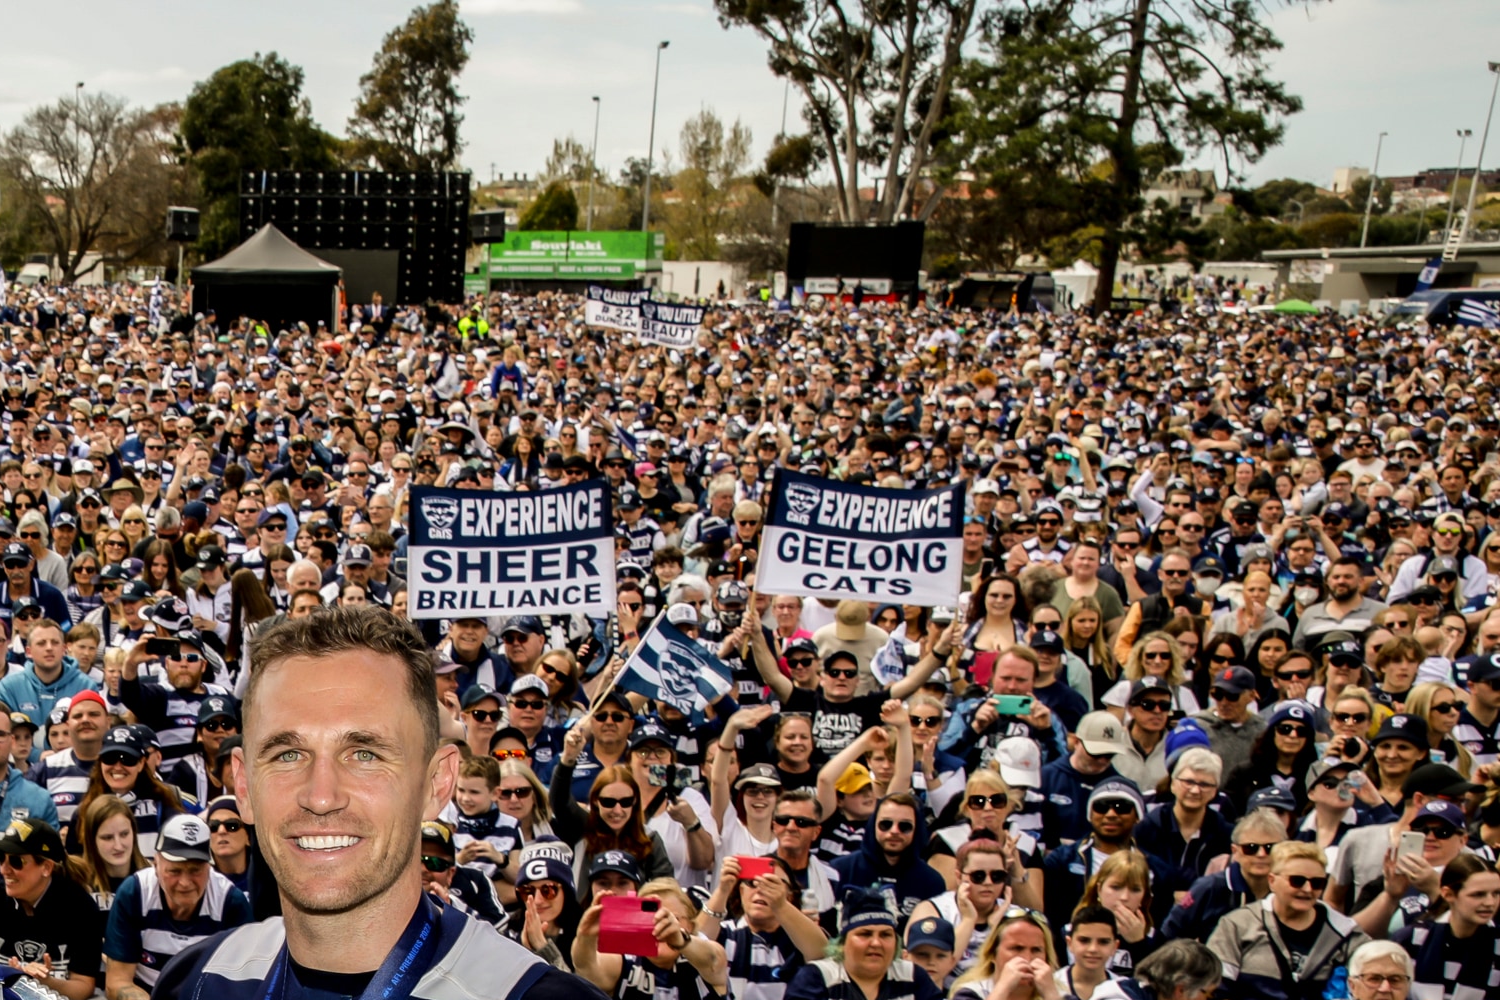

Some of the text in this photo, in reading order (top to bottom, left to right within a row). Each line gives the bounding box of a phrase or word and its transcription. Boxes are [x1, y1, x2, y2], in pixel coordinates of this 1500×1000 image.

[603, 288, 630, 305] CLASSY
[595, 314, 638, 328] DUNCAN
[616, 308, 634, 320] 22
[657, 305, 704, 324] YOU LITTLE
[641, 320, 697, 338] BEAUTY
[460, 488, 603, 537] EXPERIENCE
[785, 510, 811, 526] CATS
[817, 489, 953, 533] EXPERIENCE
[428, 527, 453, 540] CATS
[777, 531, 948, 574] GEELONG
[421, 544, 600, 584] SHEER
[802, 572, 913, 596] CATS
[416, 583, 601, 610] BRILLIANCE
[1289, 706, 1304, 718] G
[525, 860, 549, 880] G
[391, 971, 404, 986] AFL
[400, 940, 424, 973] PREMIERS
[419, 923, 432, 941] 2022
